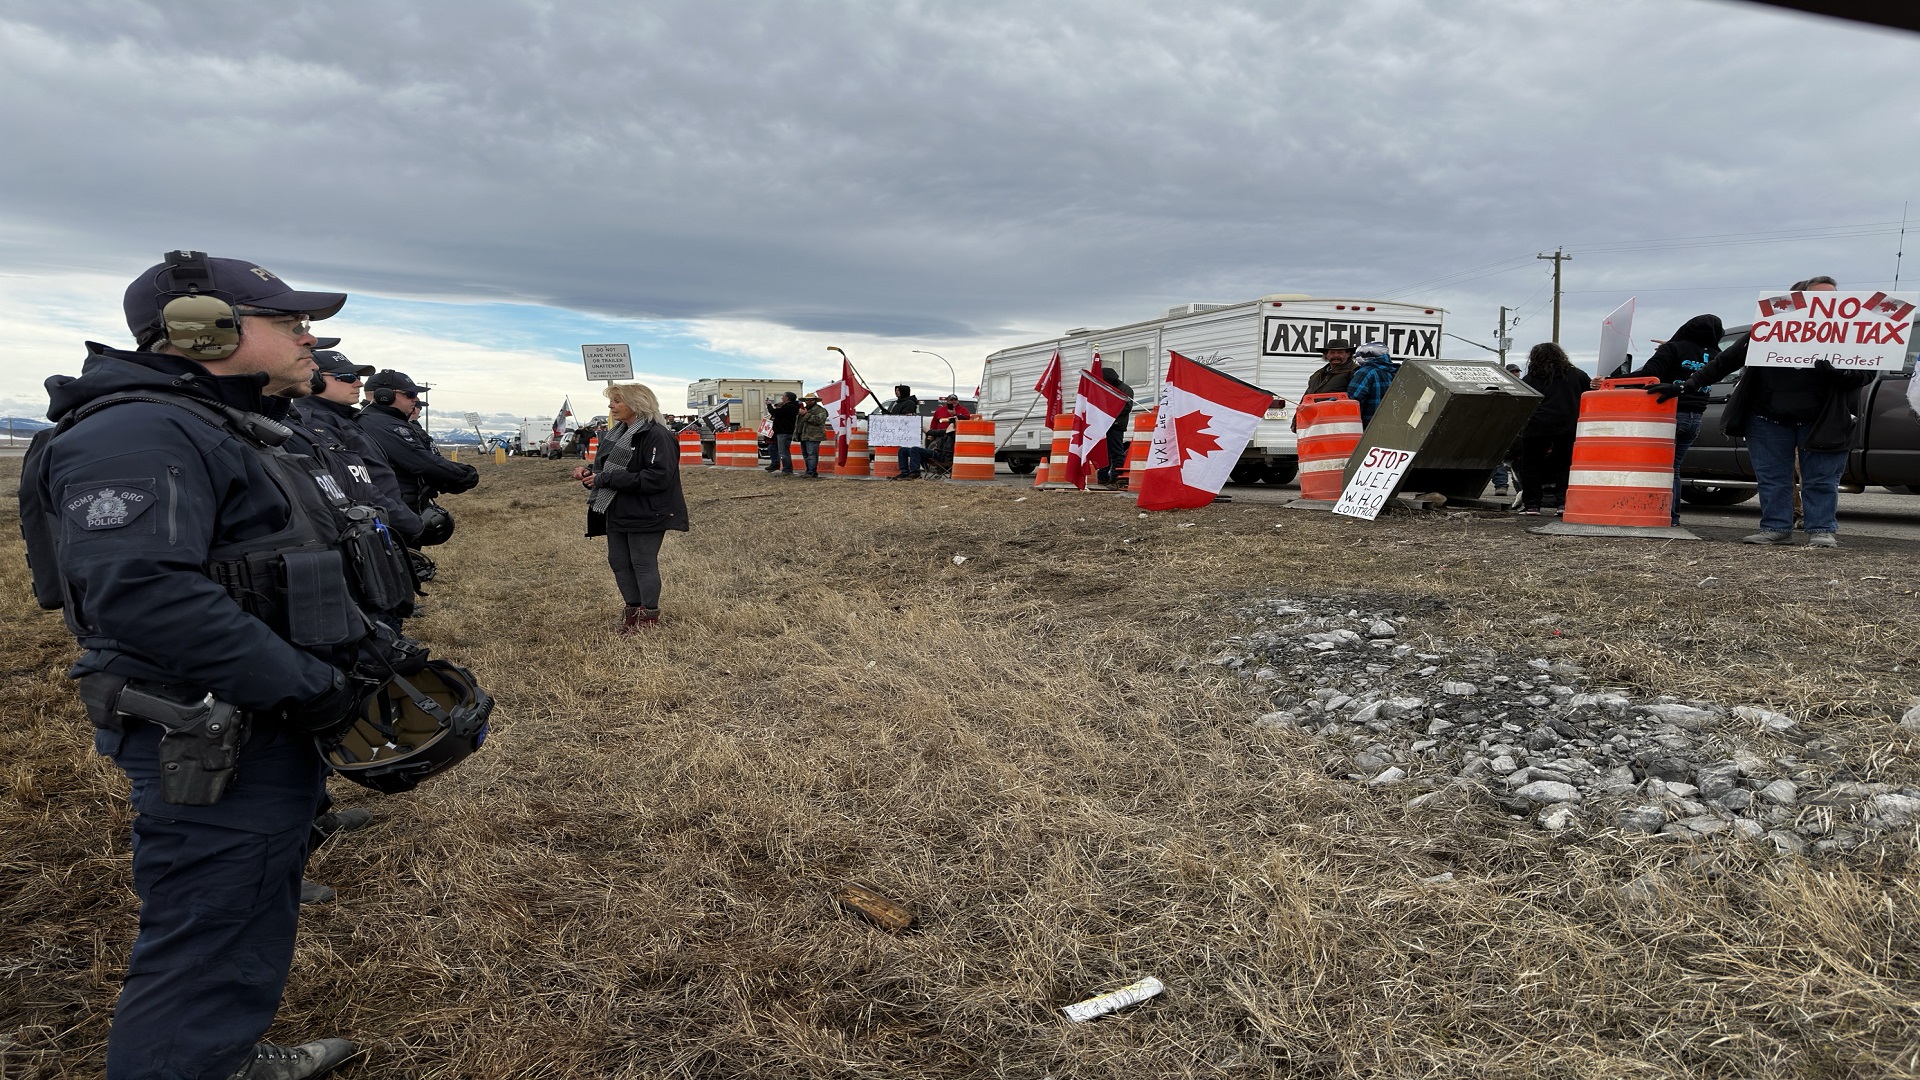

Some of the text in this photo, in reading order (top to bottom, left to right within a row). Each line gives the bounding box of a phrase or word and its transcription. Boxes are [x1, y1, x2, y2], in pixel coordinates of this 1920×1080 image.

[1809, 297, 1861, 319] NO
[1270, 323, 1323, 353] AXE
[1389, 328, 1437, 357] TAX
[1750, 321, 1909, 345] CARBON TAX
[1766, 351, 1884, 366] Peacefl Protest
[1364, 447, 1409, 470] STOP
[68, 491, 144, 511] RCMP GRC
[1338, 503, 1374, 518] CONTROL
[88, 517, 124, 527] POLICE
